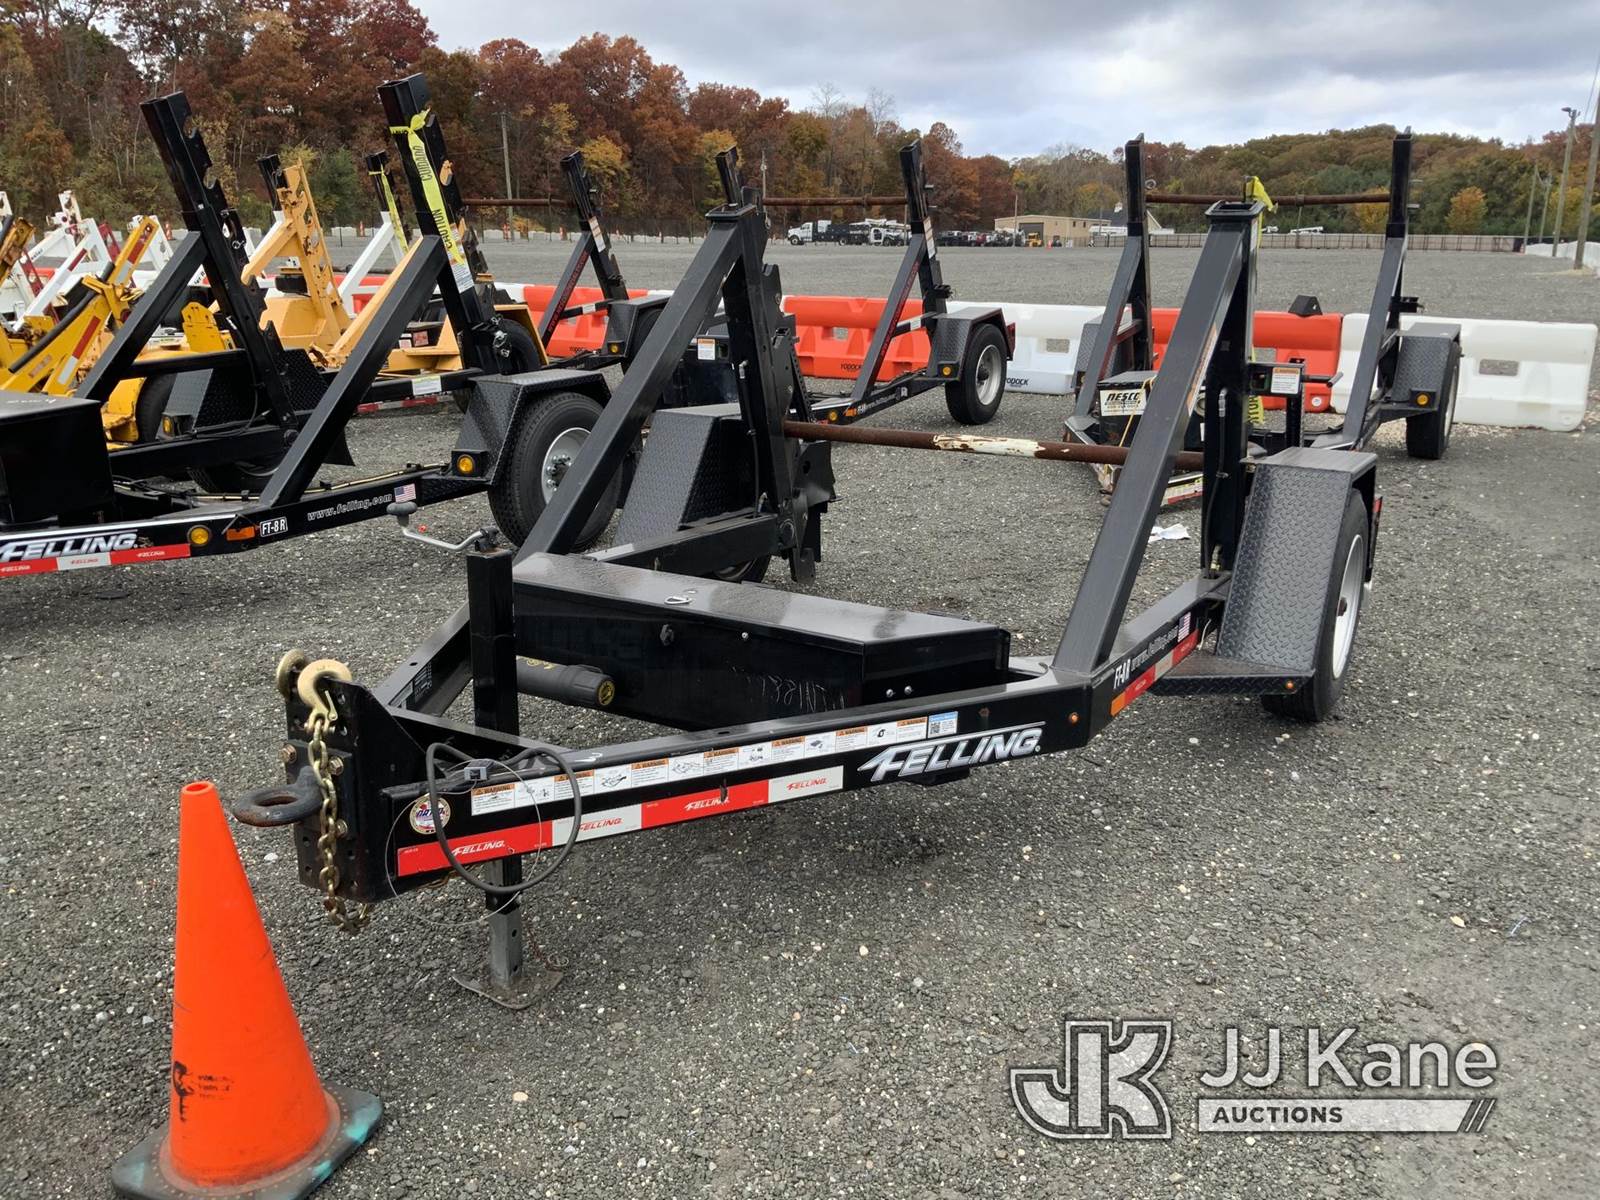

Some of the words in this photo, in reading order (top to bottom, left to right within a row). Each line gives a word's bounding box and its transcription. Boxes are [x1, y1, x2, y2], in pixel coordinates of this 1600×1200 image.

[412, 145, 433, 182] CUIDADO
[431, 208, 453, 250] CAUTION
[1006, 377, 1029, 386] ODOCK
[307, 493, 393, 521] www.felling.com
[0, 532, 138, 563] FELLING
[858, 721, 1046, 782] FELLING
[786, 777, 828, 791] FELLING
[451, 839, 505, 857] FELLING
